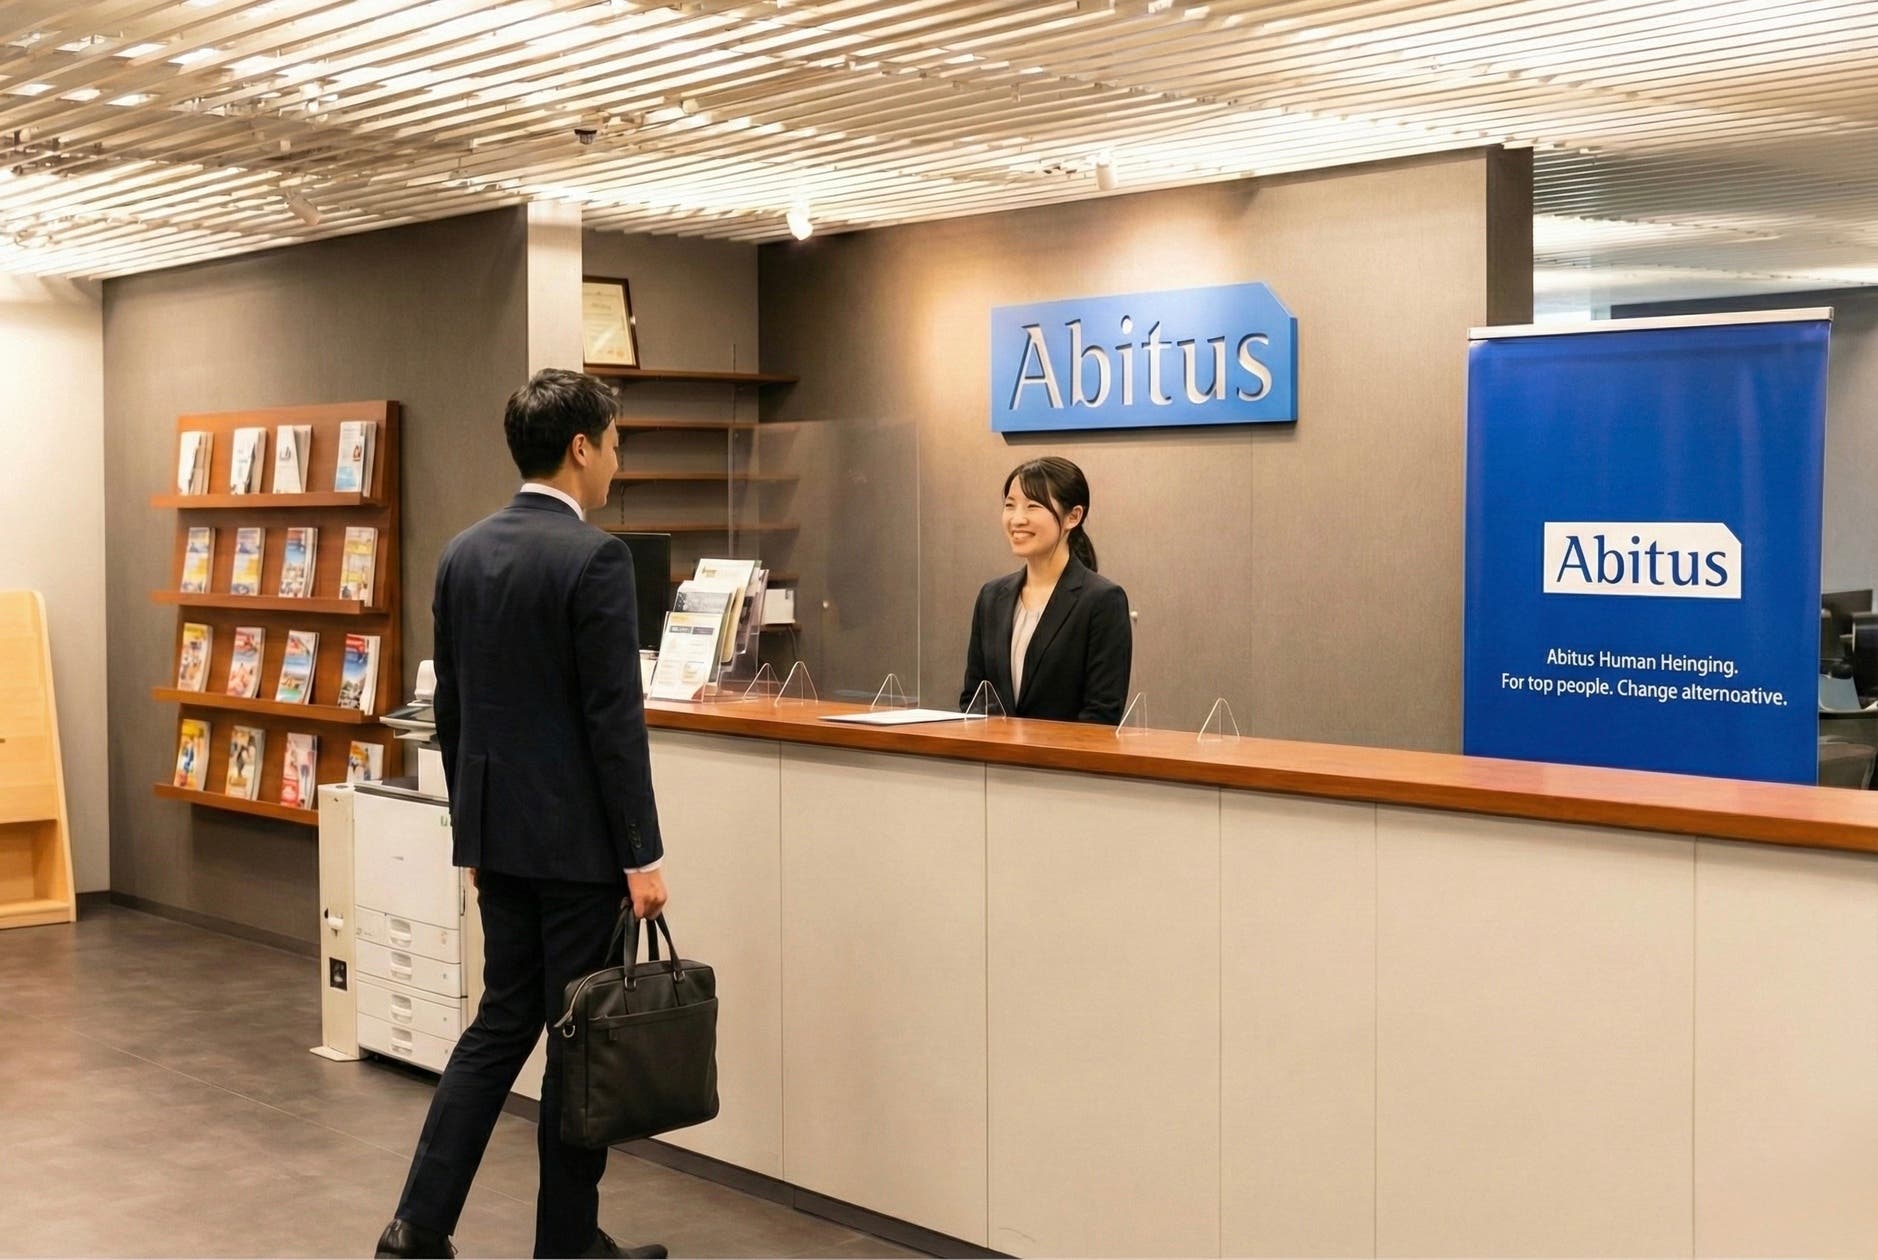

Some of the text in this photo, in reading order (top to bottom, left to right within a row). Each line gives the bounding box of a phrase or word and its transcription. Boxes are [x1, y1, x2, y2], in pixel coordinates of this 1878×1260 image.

[1008, 314, 1273, 410] Abitus
[1556, 534, 1728, 587] Abitus
[1547, 648, 1739, 678] Abitus Human Heinging.
[1501, 672, 1788, 706] For top people. Change alternoative.
